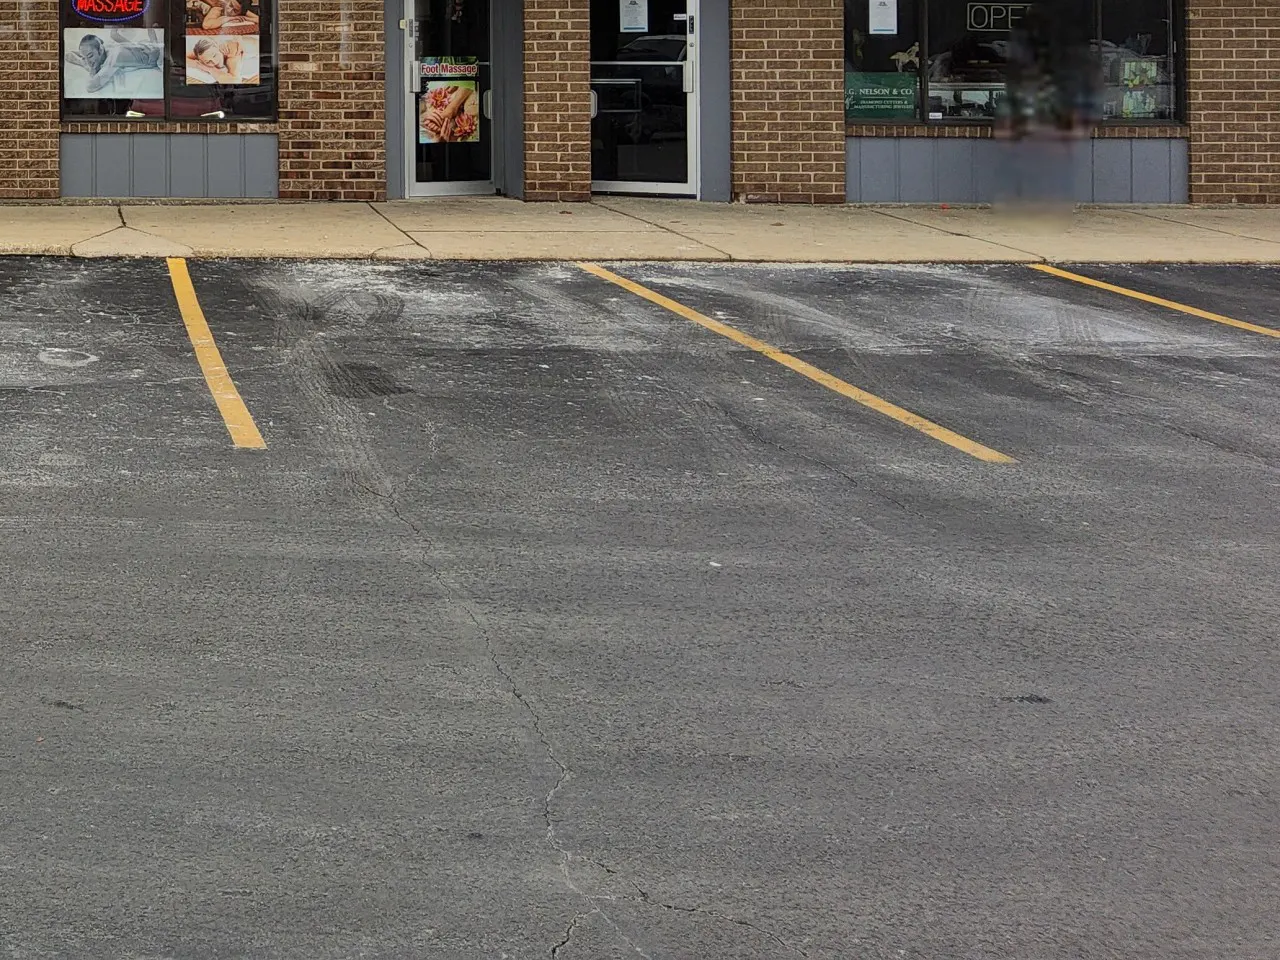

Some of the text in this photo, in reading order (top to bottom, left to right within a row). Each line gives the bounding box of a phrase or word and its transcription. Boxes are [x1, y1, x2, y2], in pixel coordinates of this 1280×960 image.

[971, 5, 1031, 28] OPE
[421, 64, 477, 76] Foot Massage
